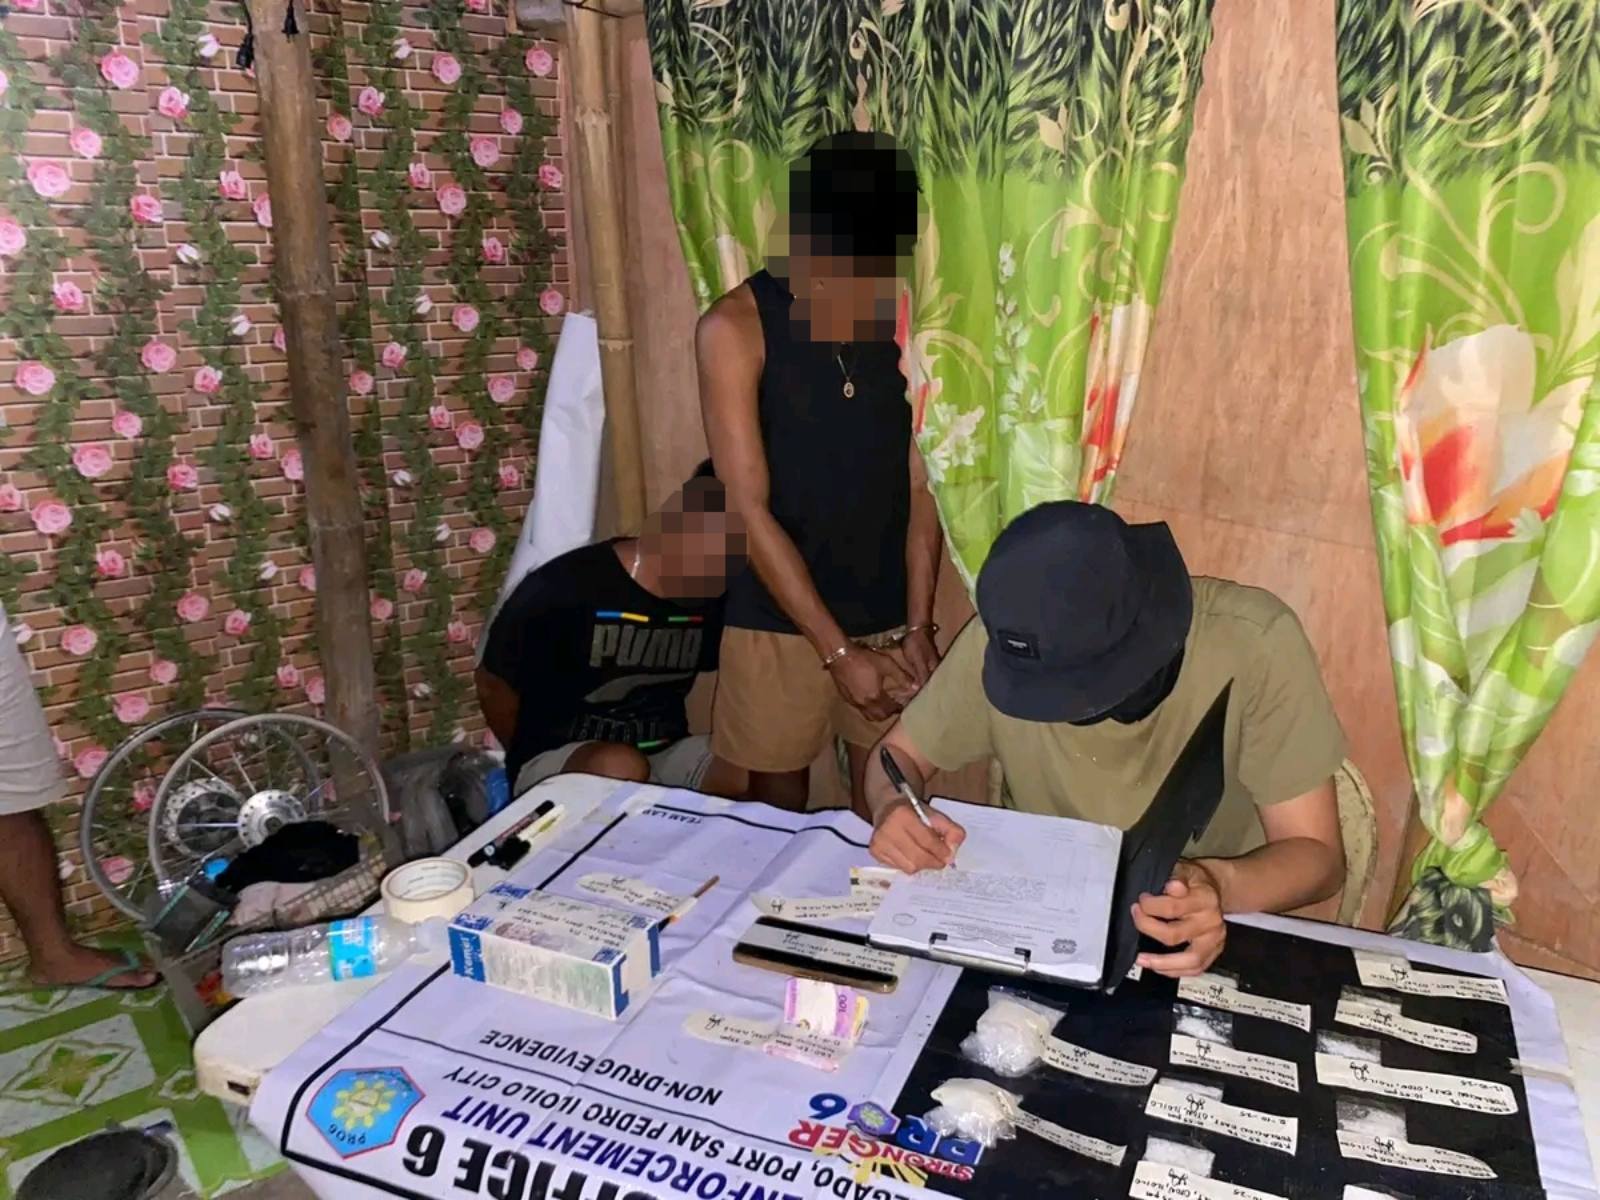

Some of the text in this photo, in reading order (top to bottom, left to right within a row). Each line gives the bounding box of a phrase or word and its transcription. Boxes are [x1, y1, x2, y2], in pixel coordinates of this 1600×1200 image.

[589, 624, 704, 669] PUMA
[441, 1066, 502, 1092] CITY
[480, 1030, 723, 1107] NON-DRUG EVIDENCE
[440, 1096, 531, 1140] UNIT
[501, 1082, 582, 1116] ILOILO
[583, 1104, 668, 1141] PEDRO
[668, 1126, 725, 1159] SAN
[402, 1126, 446, 1178] 6
[726, 1147, 802, 1183] PORT
[788, 1120, 975, 1182] STRONGER
